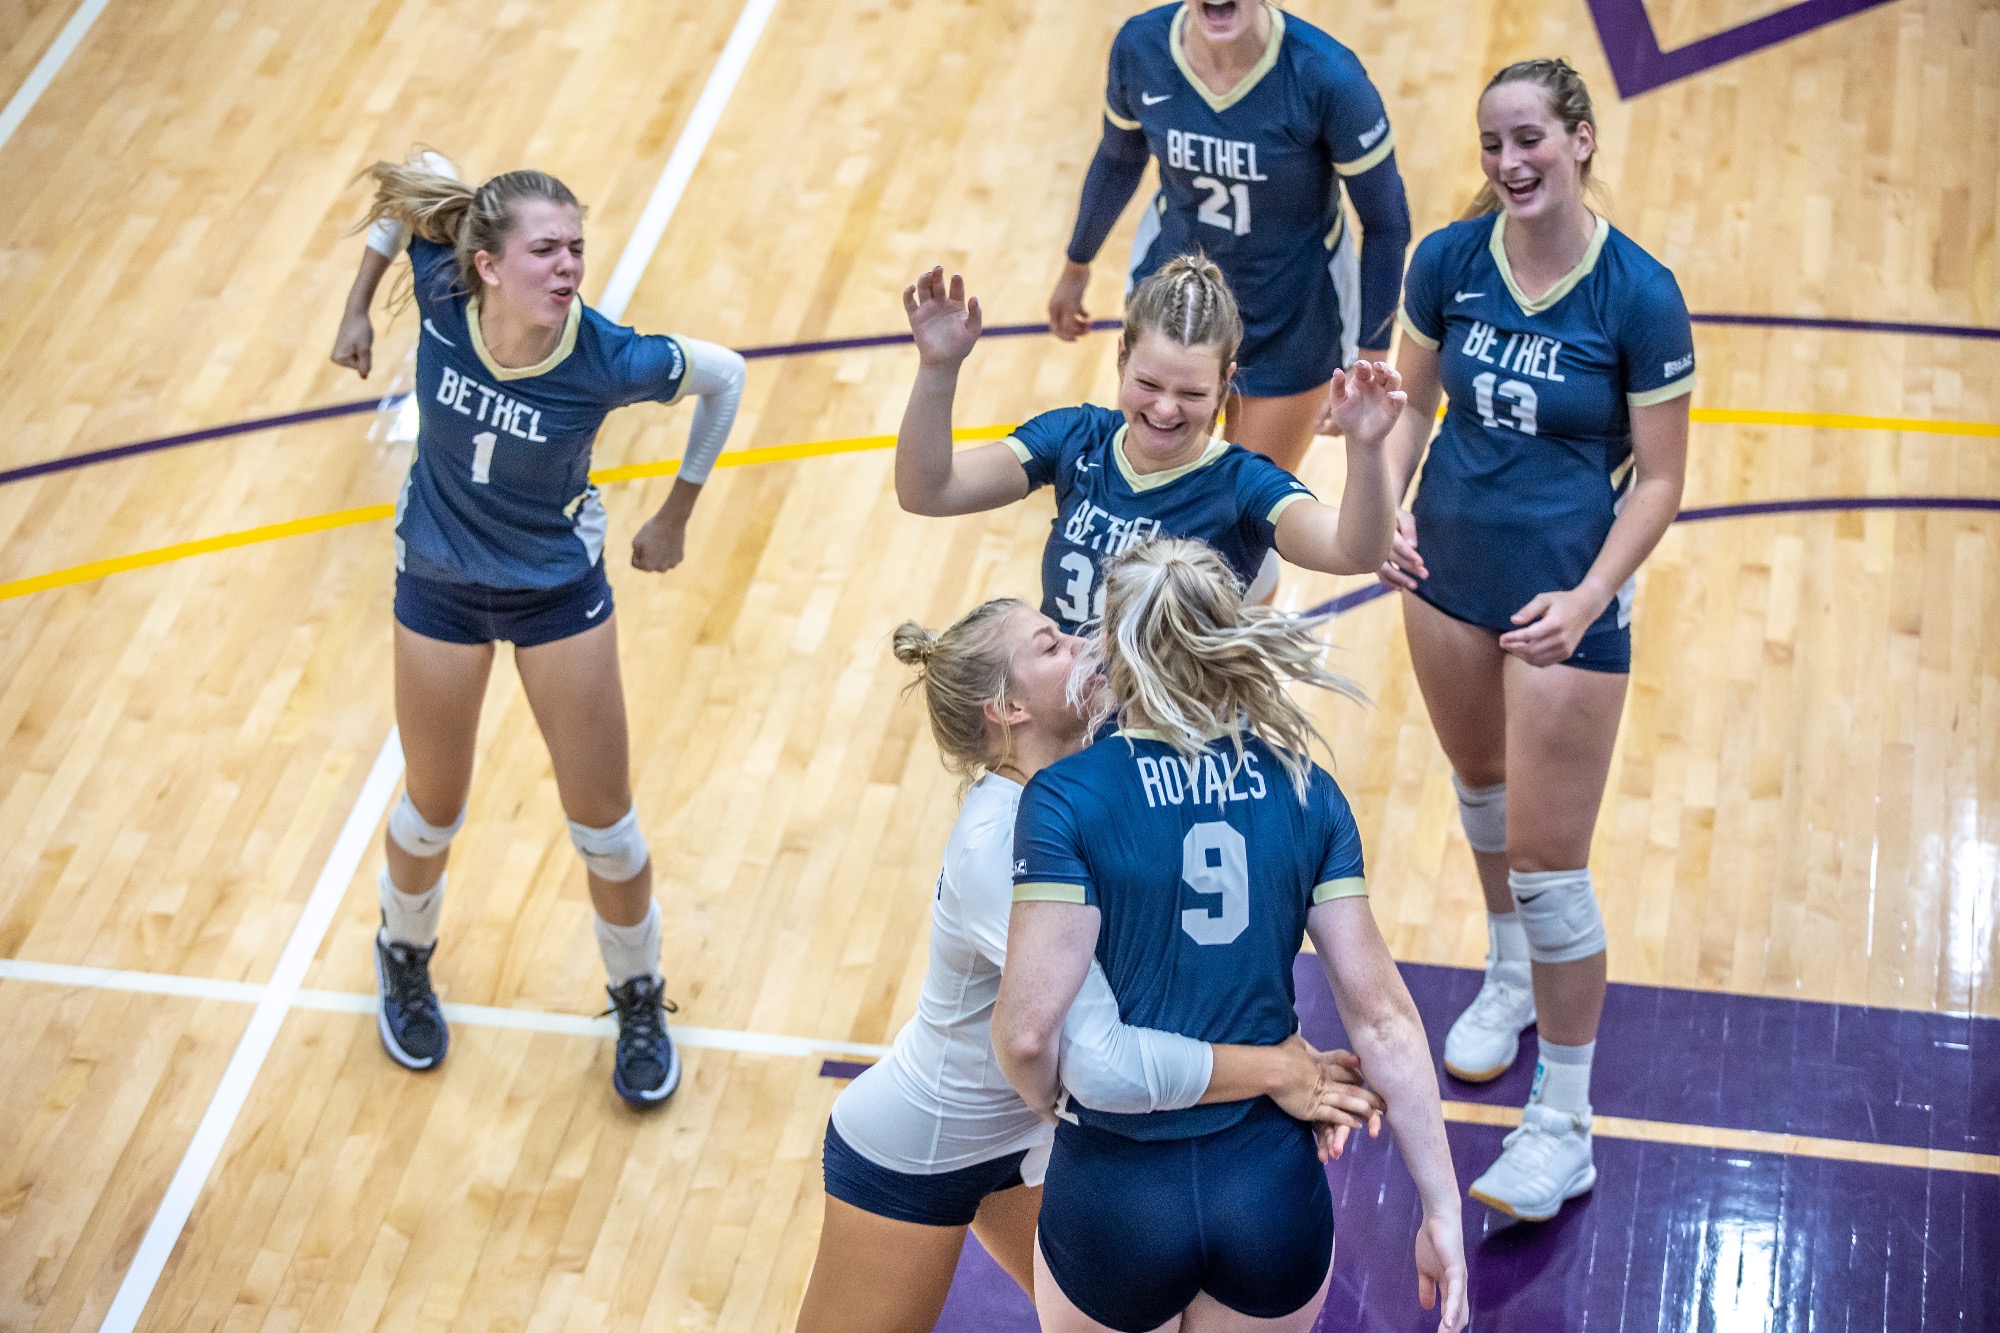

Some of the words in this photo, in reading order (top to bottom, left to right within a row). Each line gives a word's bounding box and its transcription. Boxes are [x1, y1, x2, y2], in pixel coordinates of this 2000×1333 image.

[1167, 129, 1268, 181] BETHEL
[1192, 176, 1251, 236] 21
[1461, 321, 1565, 383] BETHEL
[436, 366, 547, 442] BETHEL
[1472, 371, 1538, 436] 13
[471, 431, 497, 484] 1
[1055, 551, 1107, 623] 3
[1137, 751, 1267, 808] ROYALS
[1182, 821, 1249, 945] 9
